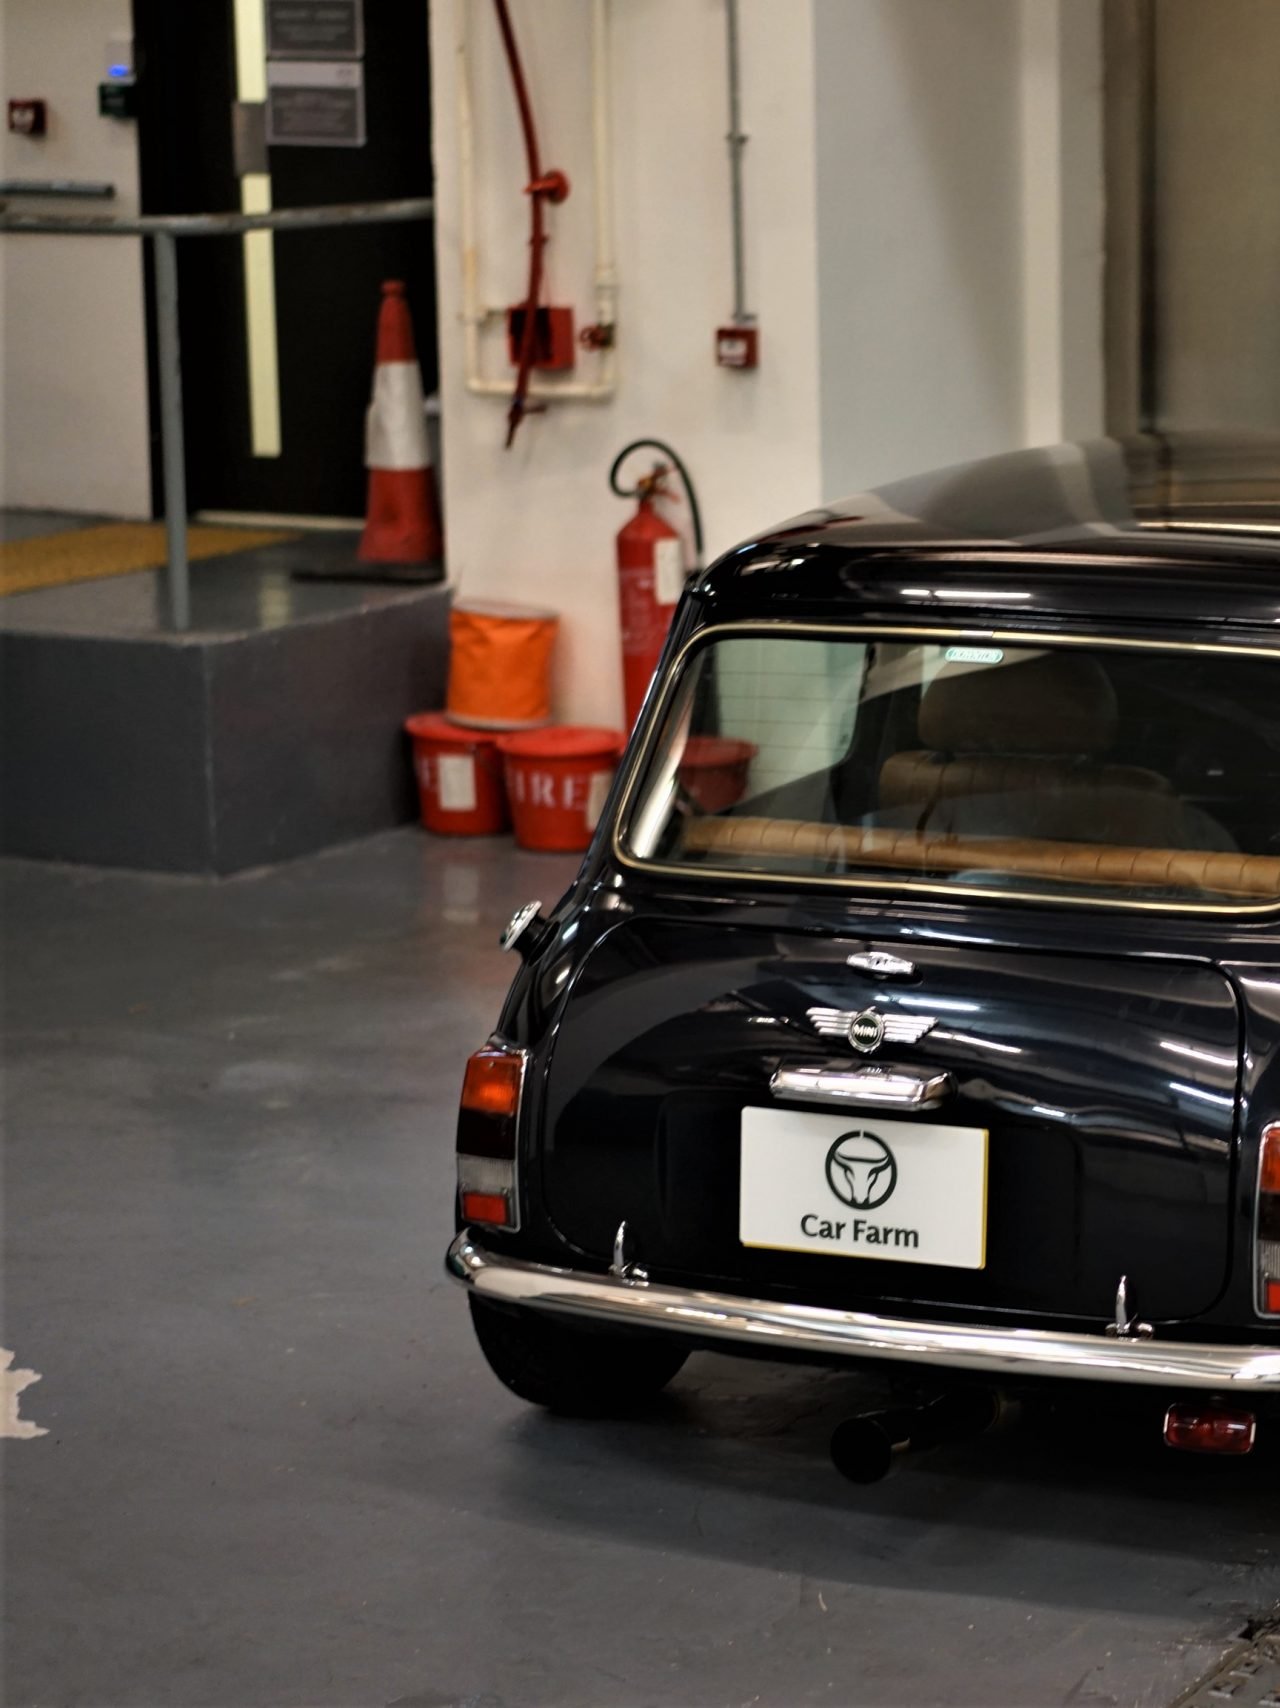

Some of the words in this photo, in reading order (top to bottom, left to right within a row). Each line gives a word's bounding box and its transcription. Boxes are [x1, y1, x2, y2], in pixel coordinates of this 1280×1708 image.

[853, 1023, 878, 1038] MINI
[800, 1213, 846, 1240] Car
[852, 1219, 920, 1248] Farm
